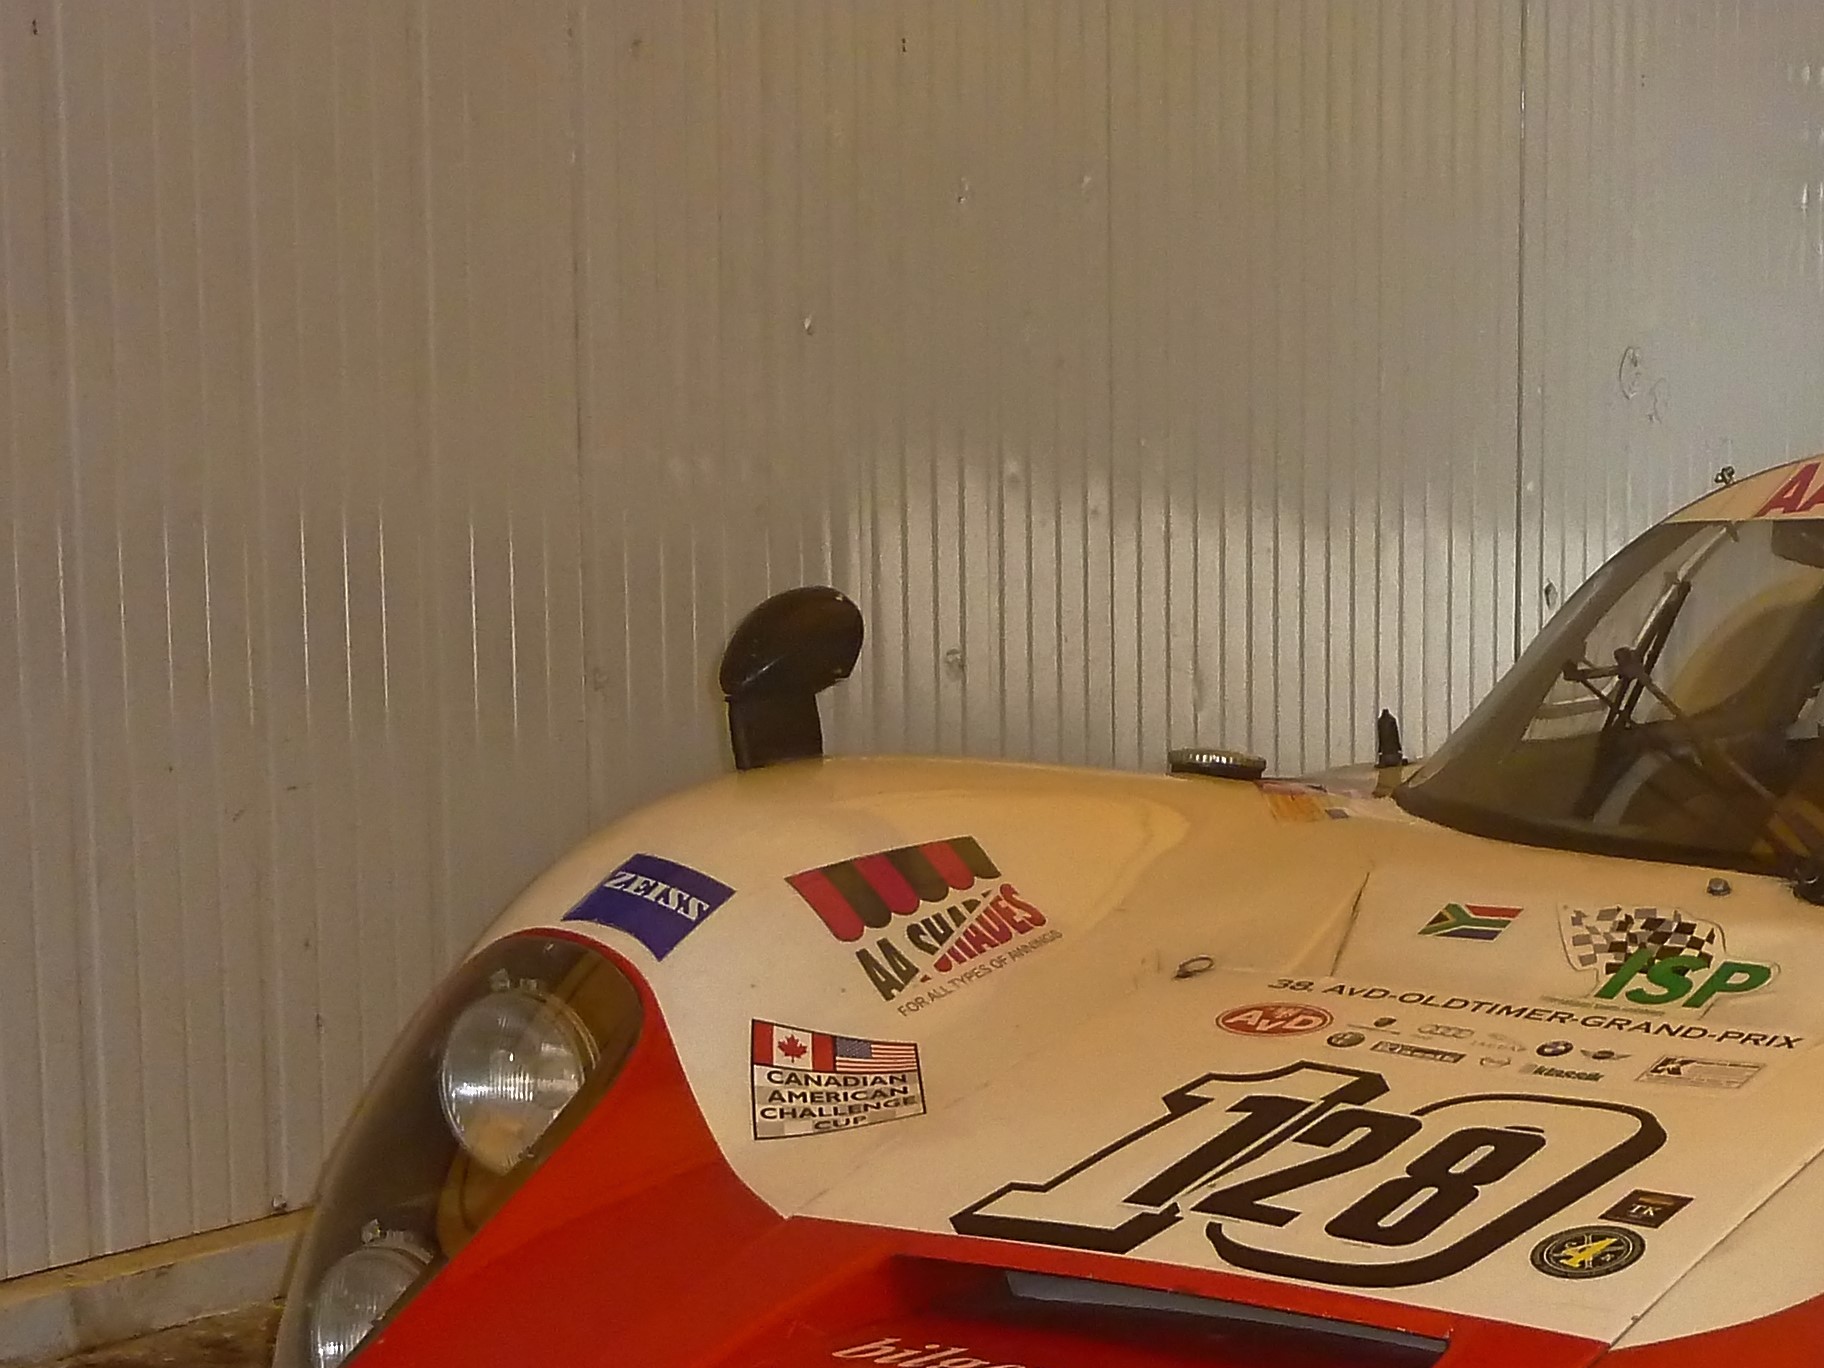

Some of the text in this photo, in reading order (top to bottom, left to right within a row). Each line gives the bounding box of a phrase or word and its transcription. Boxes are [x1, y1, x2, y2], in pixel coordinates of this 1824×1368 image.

[602, 870, 711, 922] ZEISS
[855, 937, 920, 1002] AA
[1593, 946, 1772, 1008] ISP
[897, 996, 933, 1017] FOR
[929, 981, 952, 1003] ALL
[953, 963, 993, 990] TYPES
[989, 953, 1010, 972] OF
[1267, 977, 1315, 993] 38.
[767, 1070, 908, 1088] CANADIAN
[760, 1095, 918, 1120] CHALLENGE
[768, 1086, 909, 1104] AMERICAN
[813, 1115, 868, 1131] CUP
